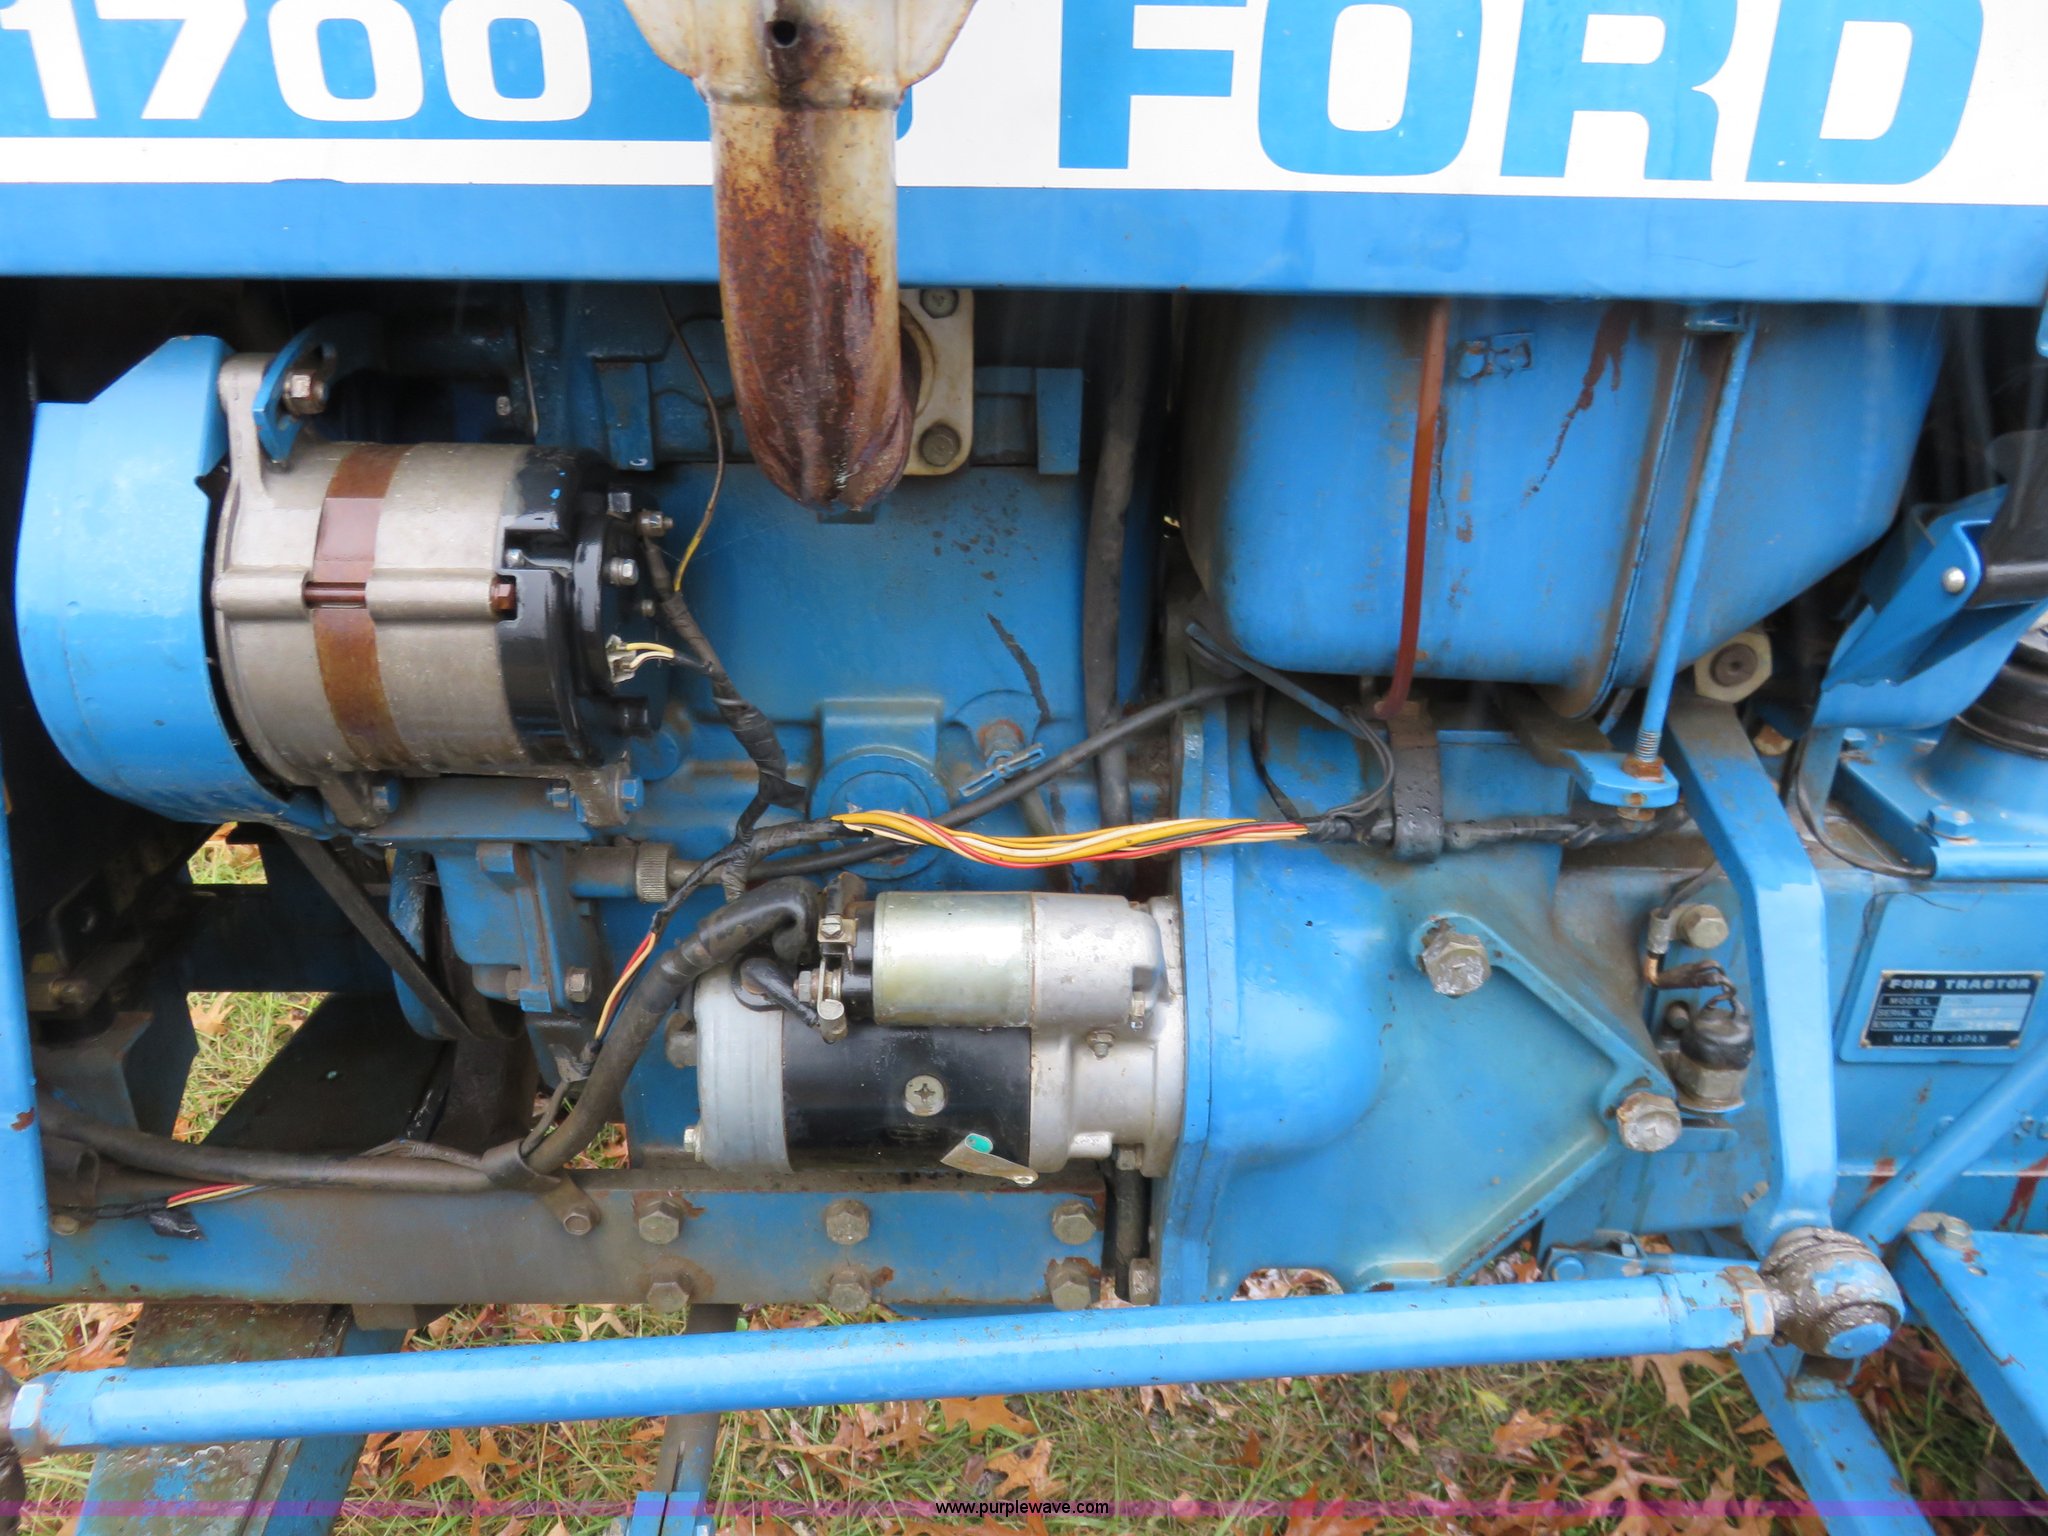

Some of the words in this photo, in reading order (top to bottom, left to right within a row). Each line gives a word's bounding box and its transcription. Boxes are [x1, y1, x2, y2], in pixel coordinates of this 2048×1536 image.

[0, 0, 593, 122] 1700
[1058, 0, 1984, 185] FORD
[1888, 979, 1938, 990] FORD
[1945, 979, 2031, 990] TRACTOR
[1889, 996, 1931, 1006] MODEL
[1892, 1034, 1929, 1044] MADE
[1932, 1034, 1944, 1044] IN
[1947, 1034, 1988, 1044] JAPAN
